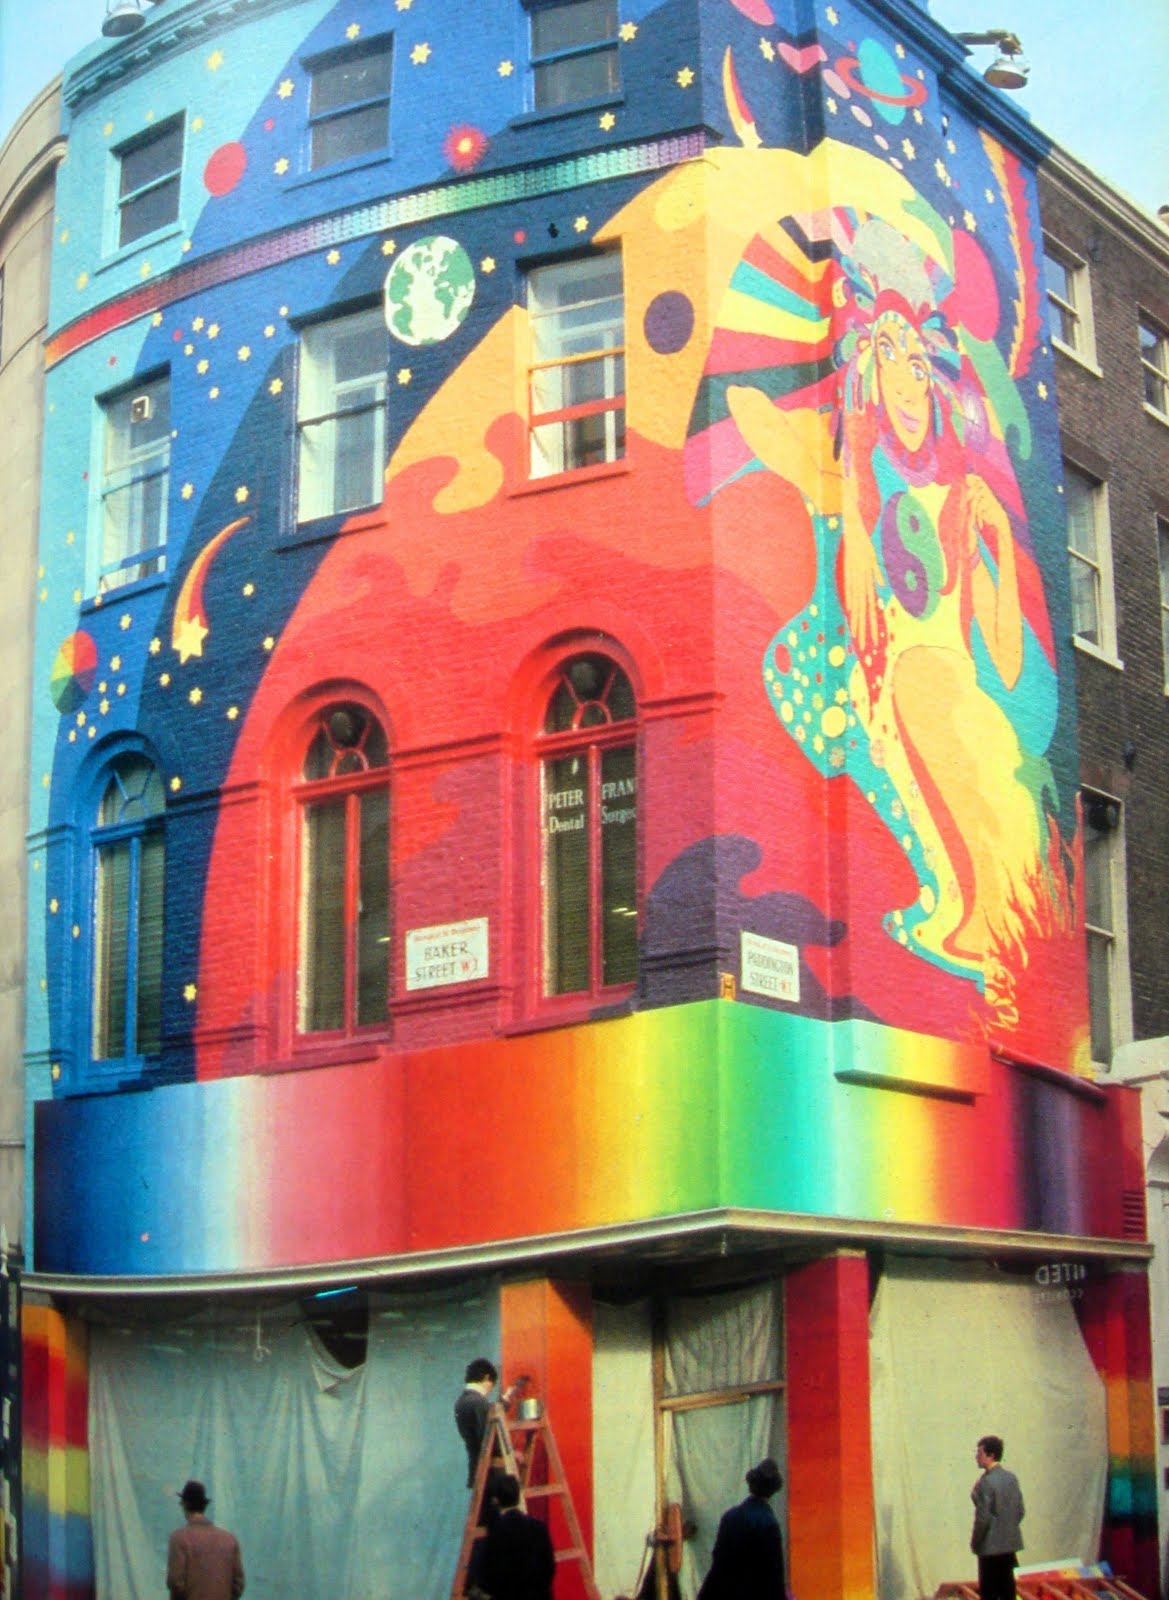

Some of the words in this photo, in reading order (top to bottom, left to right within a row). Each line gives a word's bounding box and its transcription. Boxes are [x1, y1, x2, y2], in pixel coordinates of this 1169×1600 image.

[548, 789, 584, 809] PETER
[549, 814, 584, 834] Dental
[424, 941, 468, 961] BAKER
[415, 962, 456, 982] STREET
[750, 972, 778, 992] STREET
